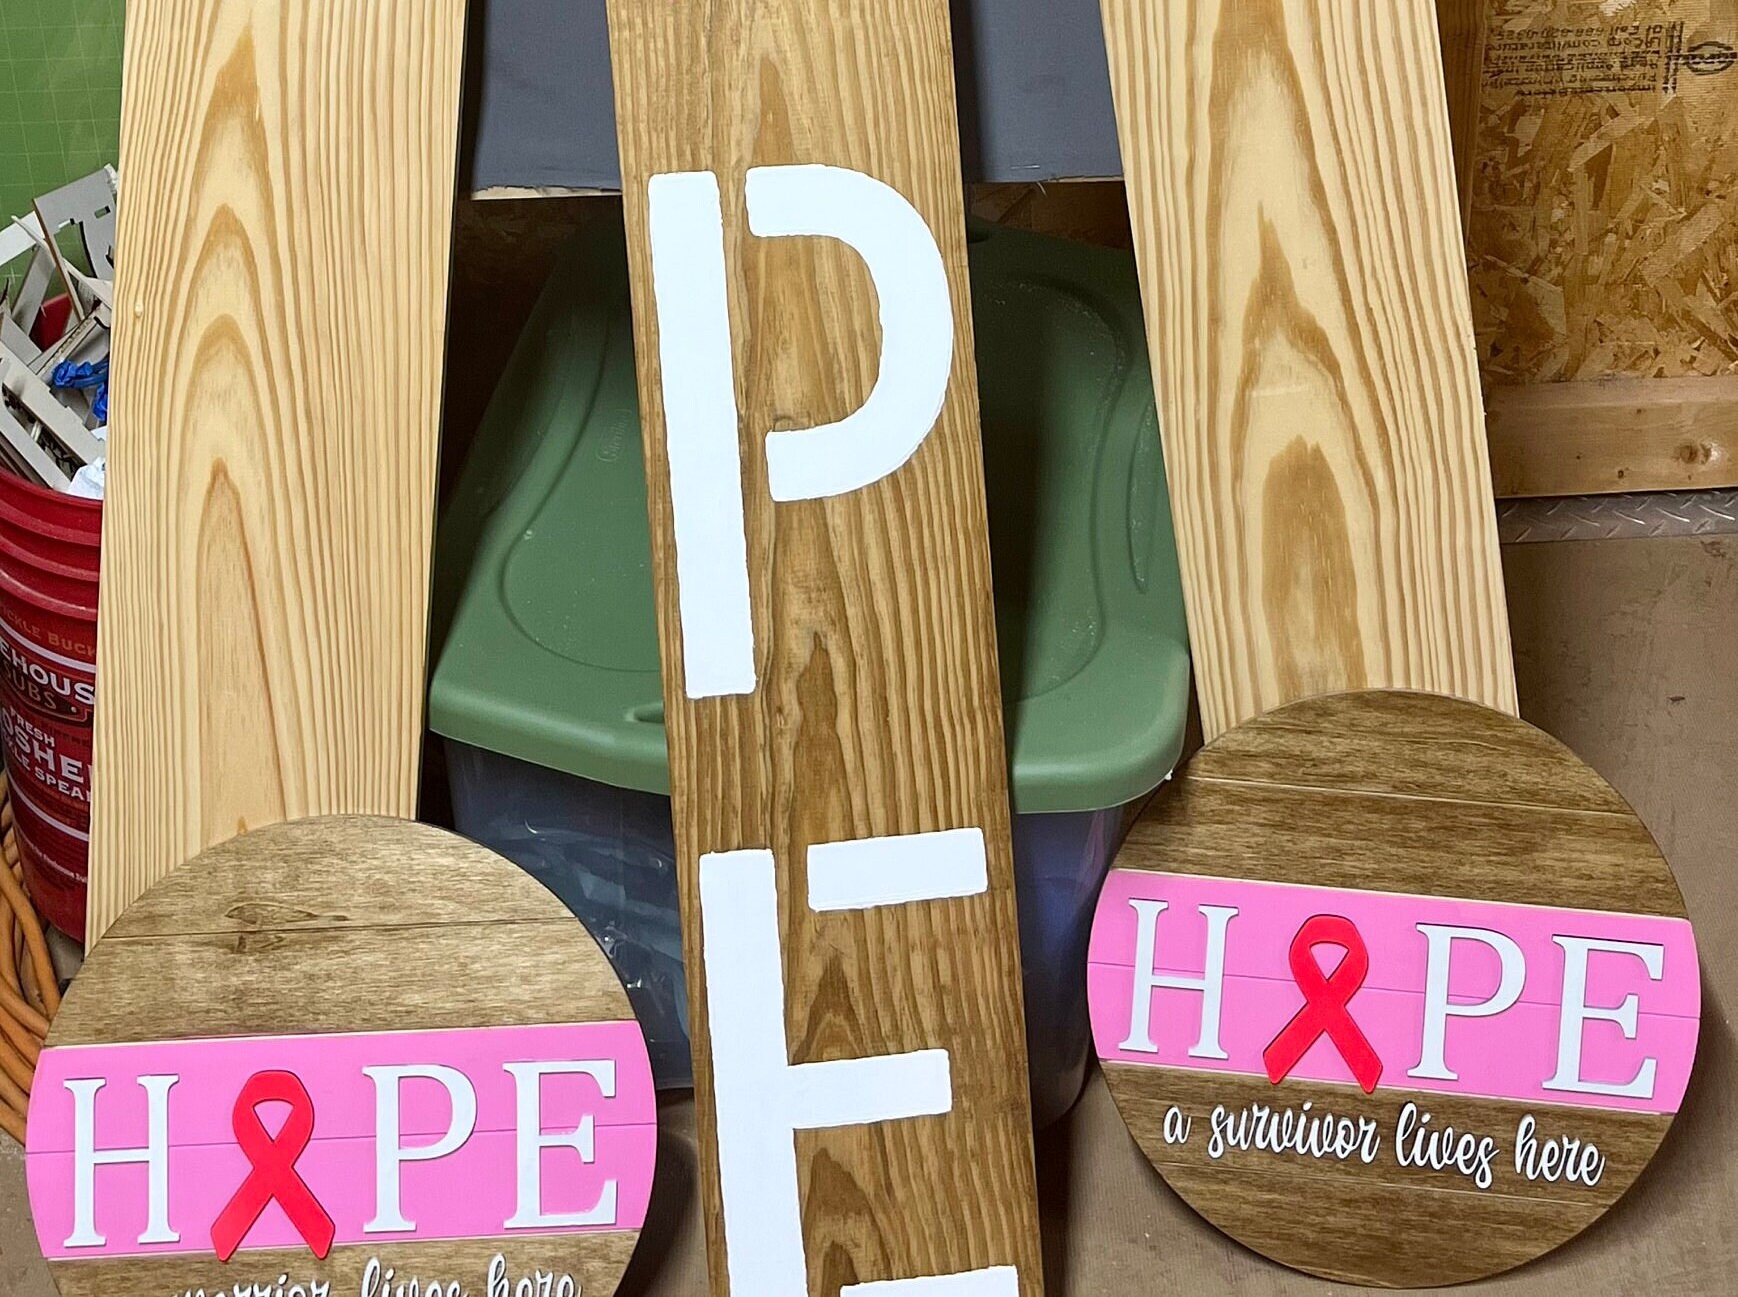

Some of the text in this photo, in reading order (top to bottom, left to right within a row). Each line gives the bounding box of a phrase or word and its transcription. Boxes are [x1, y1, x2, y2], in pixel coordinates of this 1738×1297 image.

[10, 705, 55, 747] FRESH
[1162, 1101, 1606, 1190] a survivor lives here
